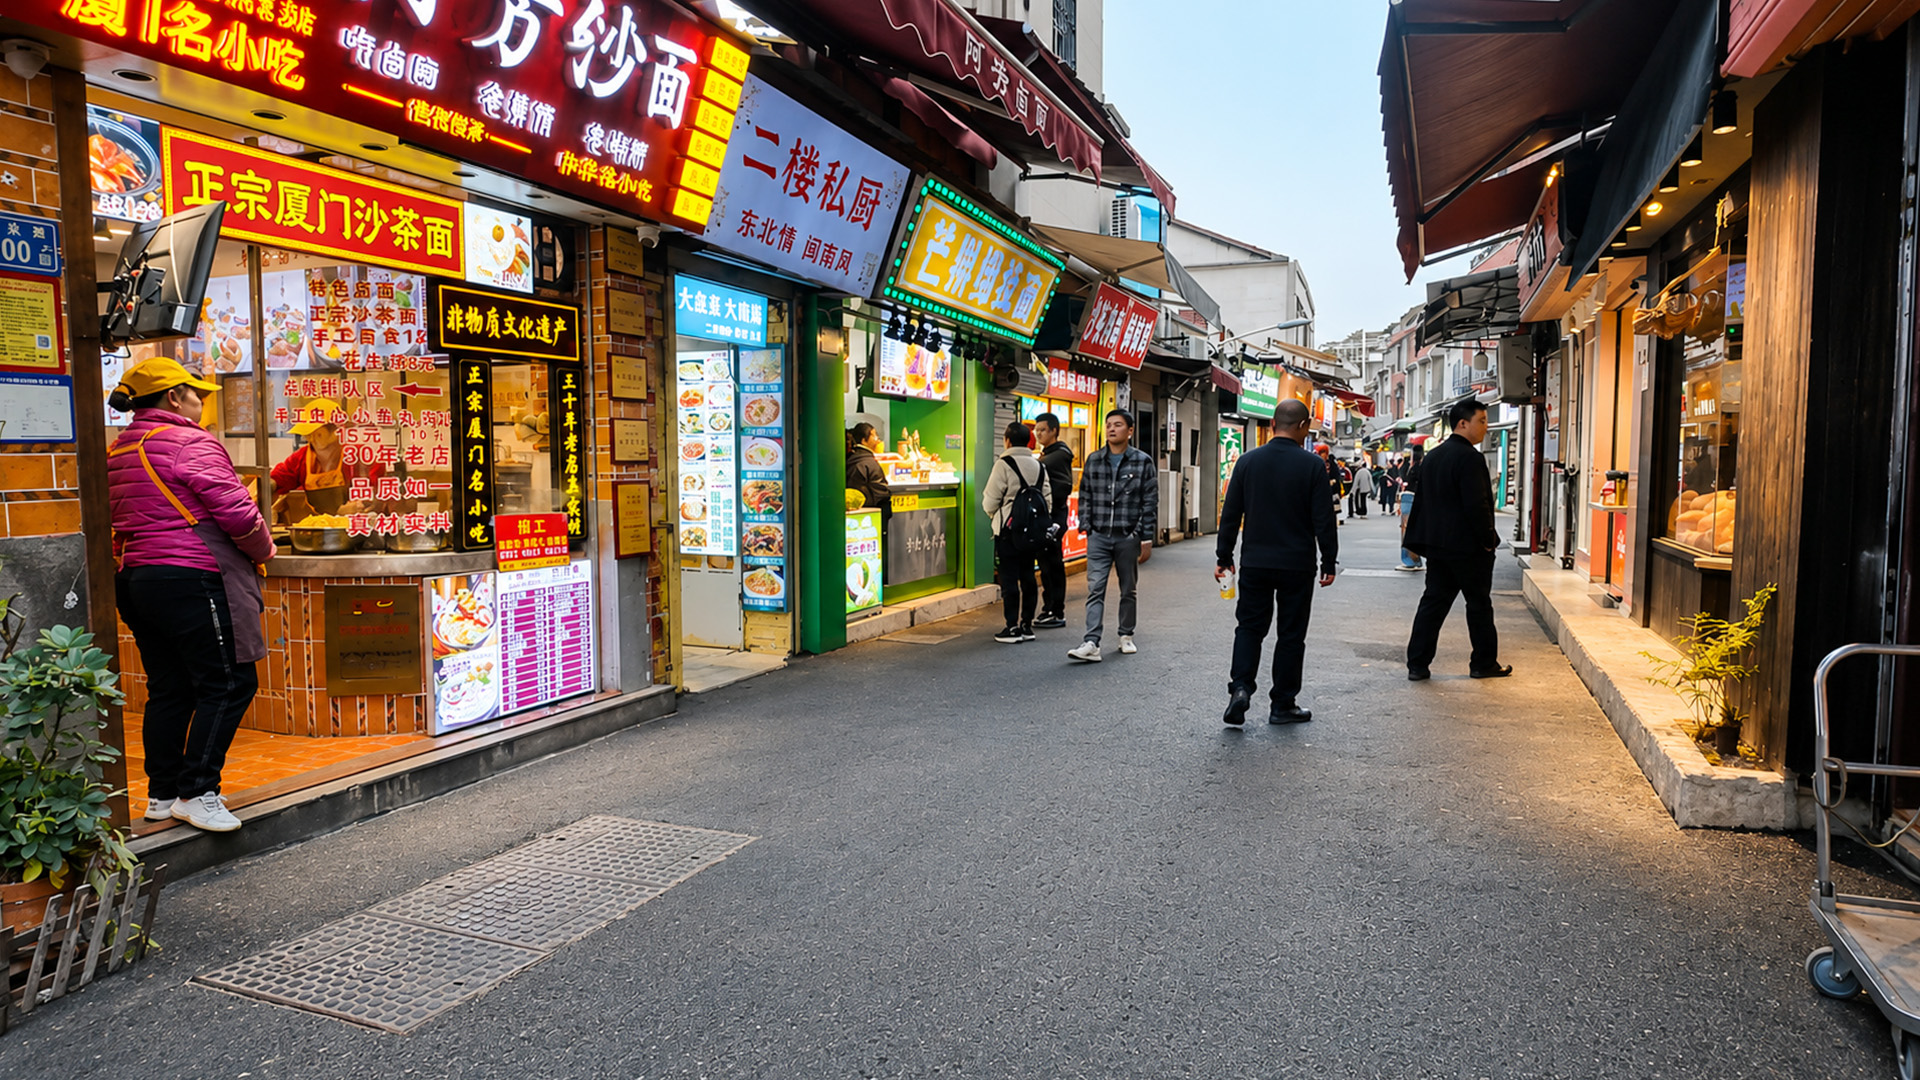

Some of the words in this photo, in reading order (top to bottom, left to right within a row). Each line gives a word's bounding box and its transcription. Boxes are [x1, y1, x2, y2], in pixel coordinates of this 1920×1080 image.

[743, 125, 884, 232] 二楼私厨
[181, 160, 455, 259] 正宗厦门沙茶面
[737, 209, 798, 254] 东北情
[342, 445, 450, 467] 30年老店
[350, 477, 452, 501] 品质如一
